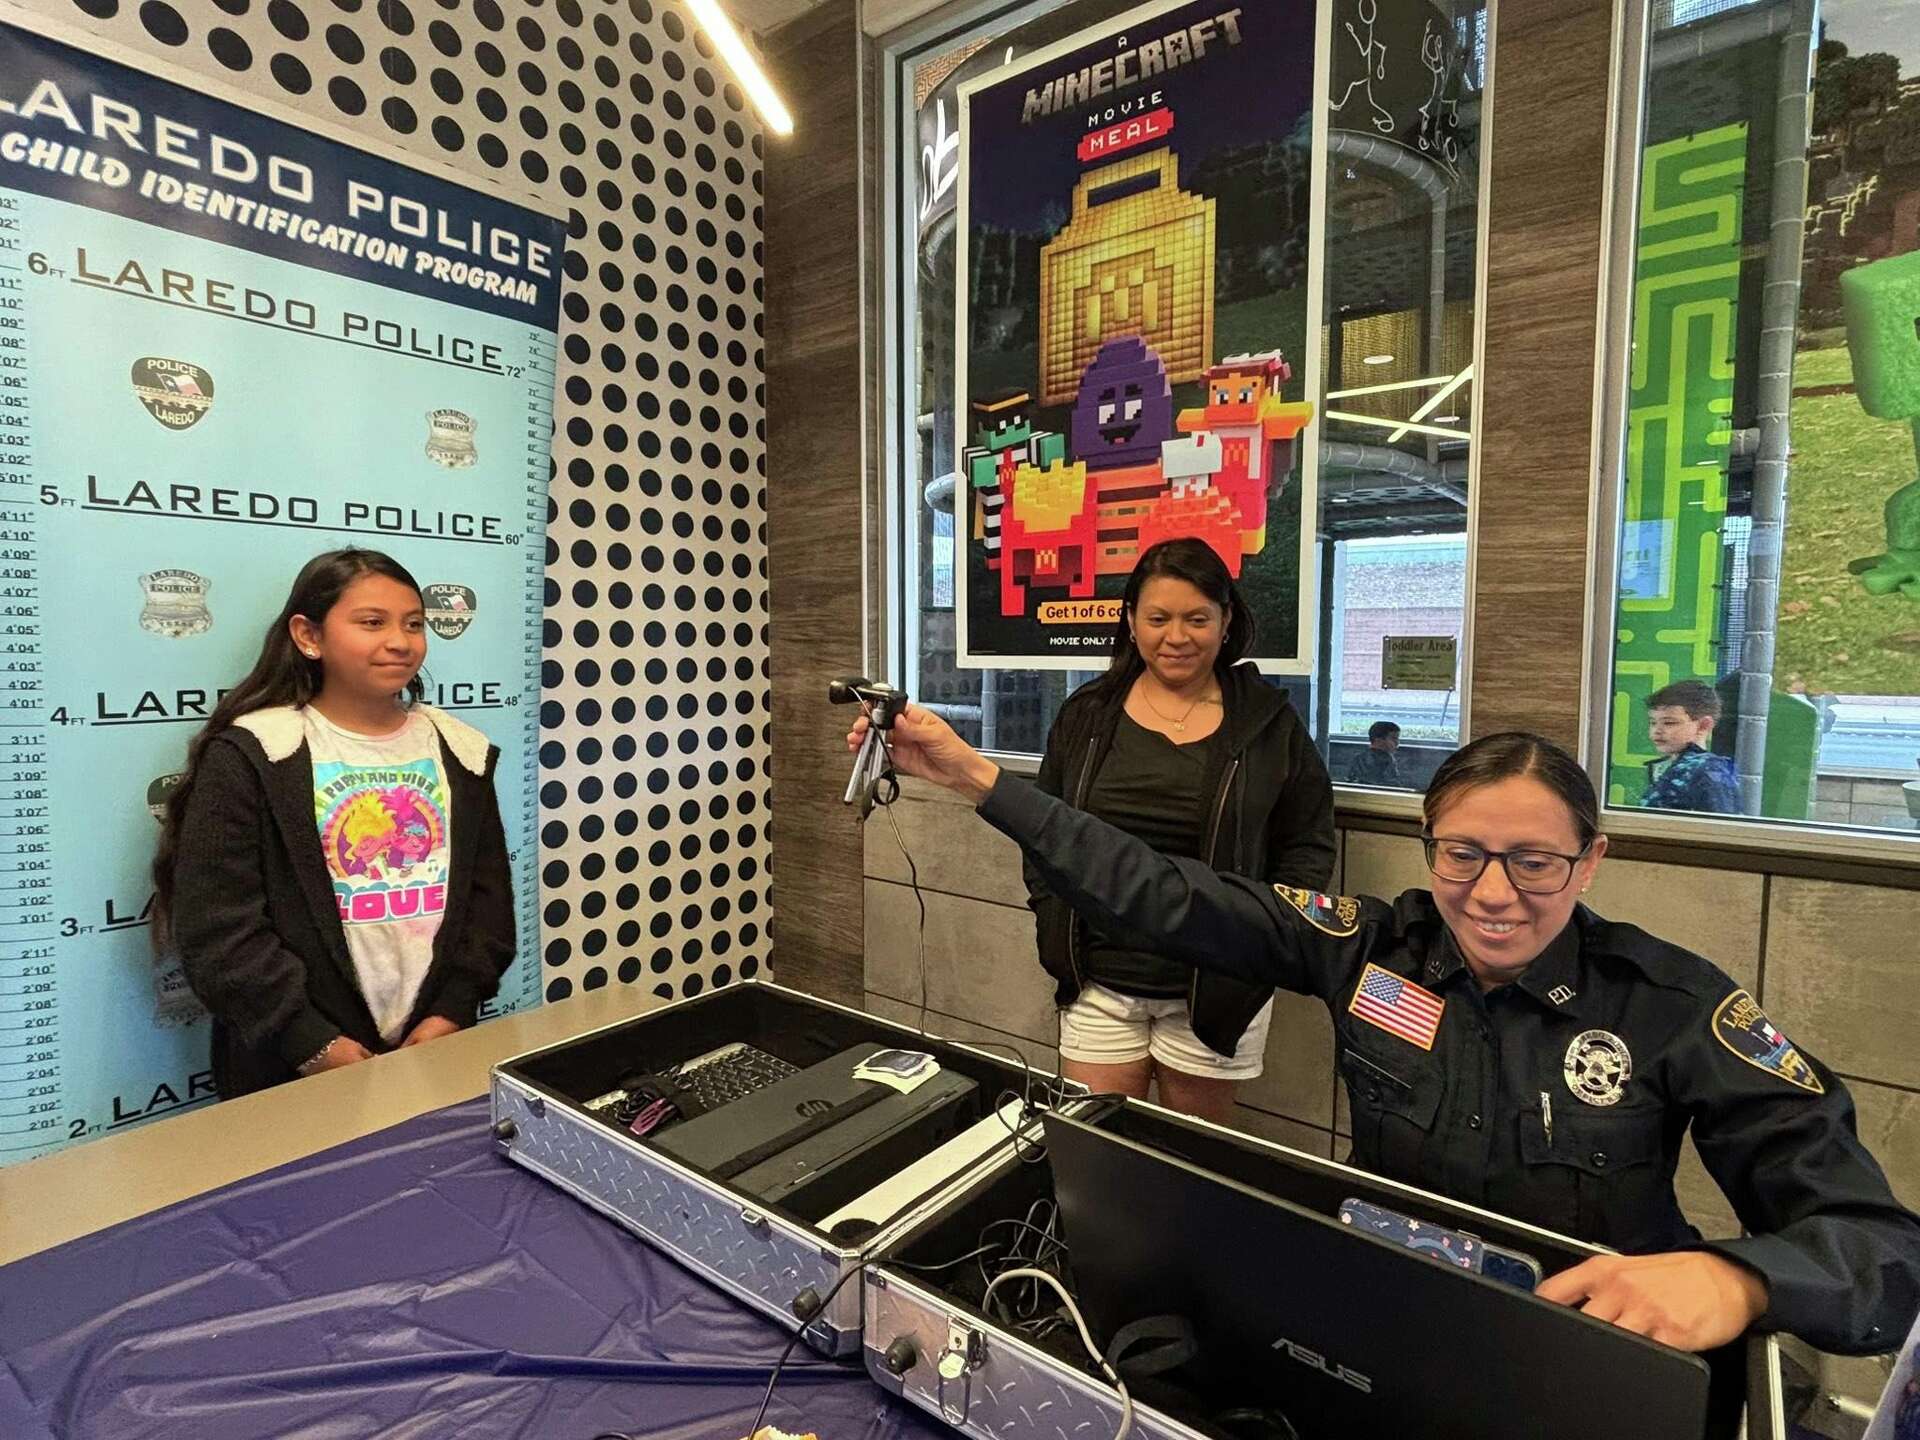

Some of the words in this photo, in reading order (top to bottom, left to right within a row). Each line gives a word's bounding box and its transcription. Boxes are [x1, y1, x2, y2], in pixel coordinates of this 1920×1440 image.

[1117, 36, 1129, 48] A
[1022, 8, 1243, 124] MINECRAFT
[1088, 90, 1163, 128] MOVIE
[1090, 122, 1159, 153] MEAL
[1, 131, 131, 188] CHILD
[140, 168, 407, 271] IDENTIFICATION
[415, 250, 537, 306] PROGRAM
[347, 179, 552, 279] POLICE
[77, 247, 316, 330] LAREDO
[343, 312, 503, 370] POLICE
[505, 365, 526, 379] 72"
[147, 359, 199, 377] POLICE
[155, 406, 195, 425] LAREDO
[88, 474, 317, 524] LAREDO
[344, 502, 501, 538] POLICE
[505, 533, 524, 546] 60"
[150, 570, 200, 582] LAREDO
[3, 587, 38, 597] 4'07"
[152, 584, 200, 593] POLICE
[430, 585, 466, 597] POLICE
[4, 606, 38, 616] 4'06"
[1046, 606, 1069, 619] Get
[1072, 606, 1078, 618] 1
[1080, 604, 1094, 618] of
[1096, 605, 1105, 618] 6
[6, 624, 39, 634] 4'05"
[1049, 636, 1080, 646] MOVIE
[1082, 636, 1108, 646] ONLY
[6, 643, 40, 653] 4'04"
[7, 661, 41, 671] 4'03"
[8, 680, 42, 690] 4'02"
[9, 698, 43, 709] 4'01"
[504, 693, 522, 707] 48"
[11, 734, 45, 745] 3'11"
[12, 752, 46, 763] 3'10"
[13, 770, 47, 781] 3'09"
[323, 772, 365, 799] POPPY
[367, 771, 398, 783] AND
[14, 788, 47, 799] 3'08"
[15, 806, 48, 817] 3'07"
[16, 824, 49, 835] 3'06"
[17, 842, 50, 853] 3'05"
[17, 859, 51, 870] 3'04"
[18, 877, 51, 888] 3'03"
[20, 895, 52, 905] 3'02"
[20, 912, 53, 924] 3'01"
[21, 947, 54, 959] 2'11"
[23, 964, 55, 976] 2'10"
[23, 981, 56, 994] 2'09"
[24, 998, 57, 1011] 2'08"
[502, 998, 520, 1014] 24"
[25, 1015, 58, 1029] 2'07"
[26, 1032, 58, 1045] 2'06"
[26, 1050, 59, 1063] 2'05"
[27, 1067, 60, 1080] 2'04"
[28, 1083, 61, 1097] 2'03"
[29, 1100, 61, 1114] 2'02"
[30, 1116, 63, 1131] 2'01"
[1271, 1337, 1372, 1393] ASUS
